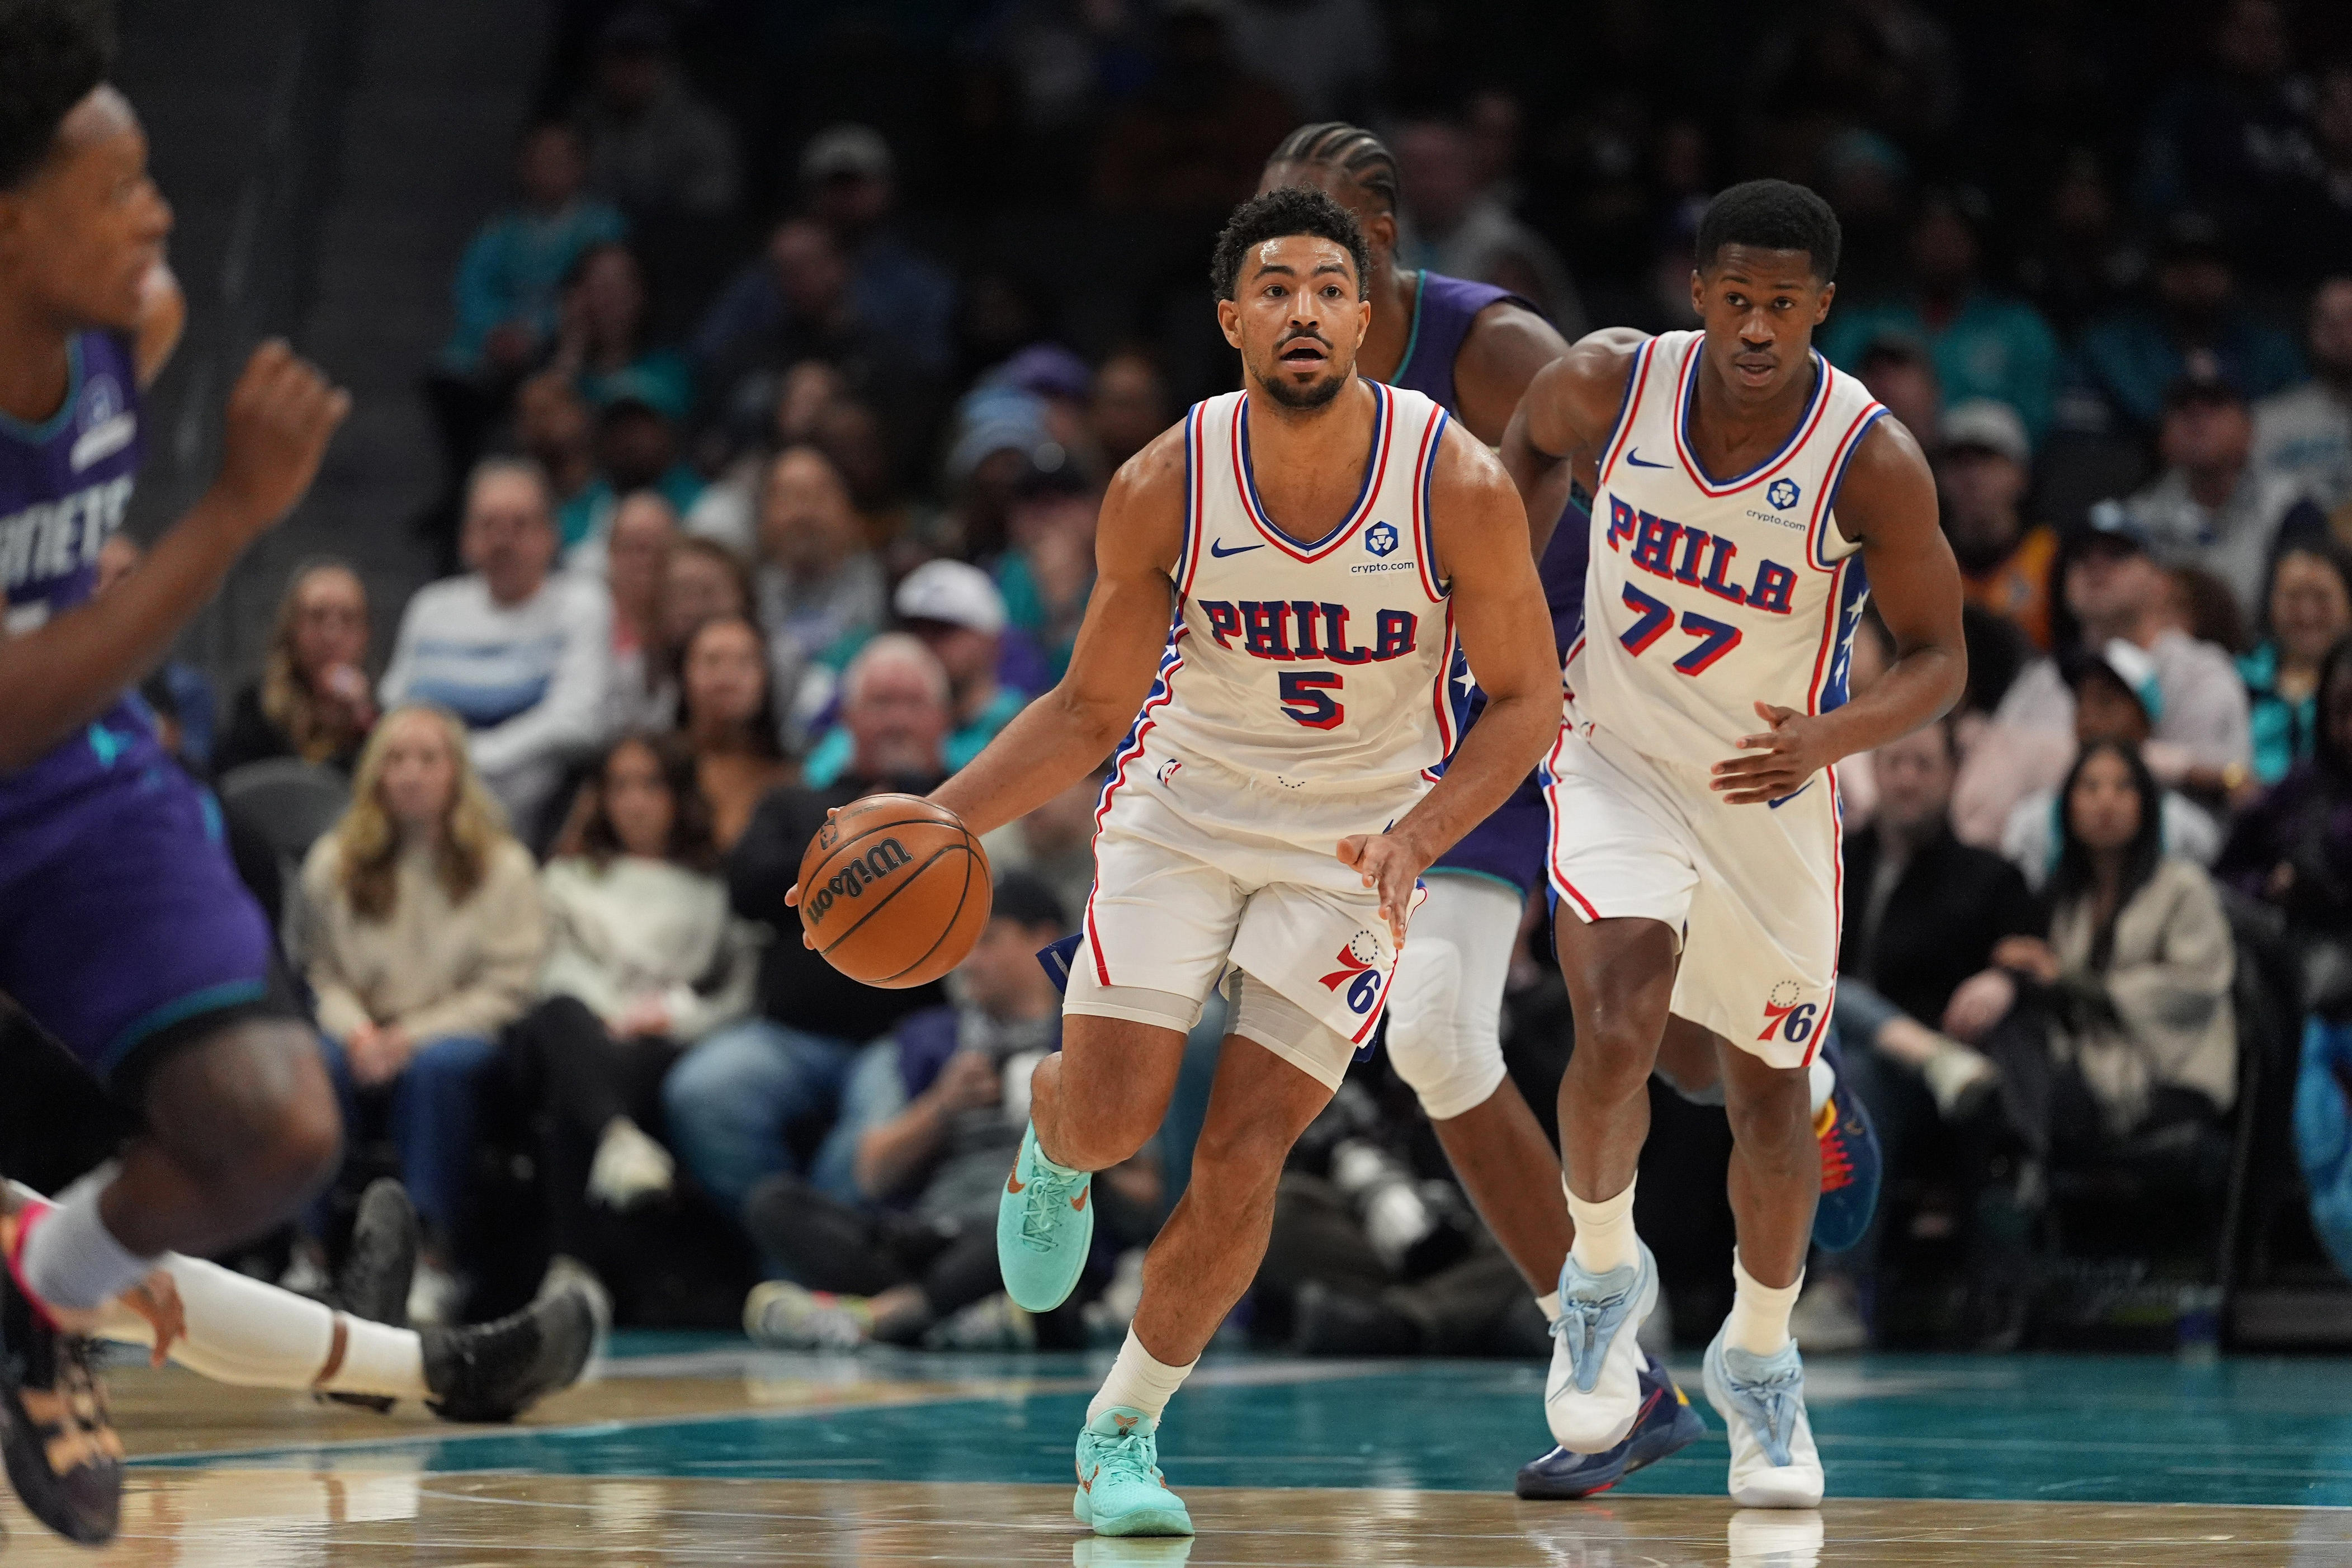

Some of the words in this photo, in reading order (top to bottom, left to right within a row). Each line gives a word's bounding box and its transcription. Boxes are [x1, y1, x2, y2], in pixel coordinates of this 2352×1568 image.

[1746, 510, 1805, 531] crypto.com
[1351, 562, 1414, 573] crypto.com
[1607, 492, 1798, 615] PHILA
[1198, 600, 1418, 665] PHILA
[1619, 581, 1742, 677] 77
[1278, 671, 1343, 730] 5
[807, 838, 914, 925] Wilson
[1319, 943, 1381, 1014] 76
[1757, 1000, 1816, 1042] 76
